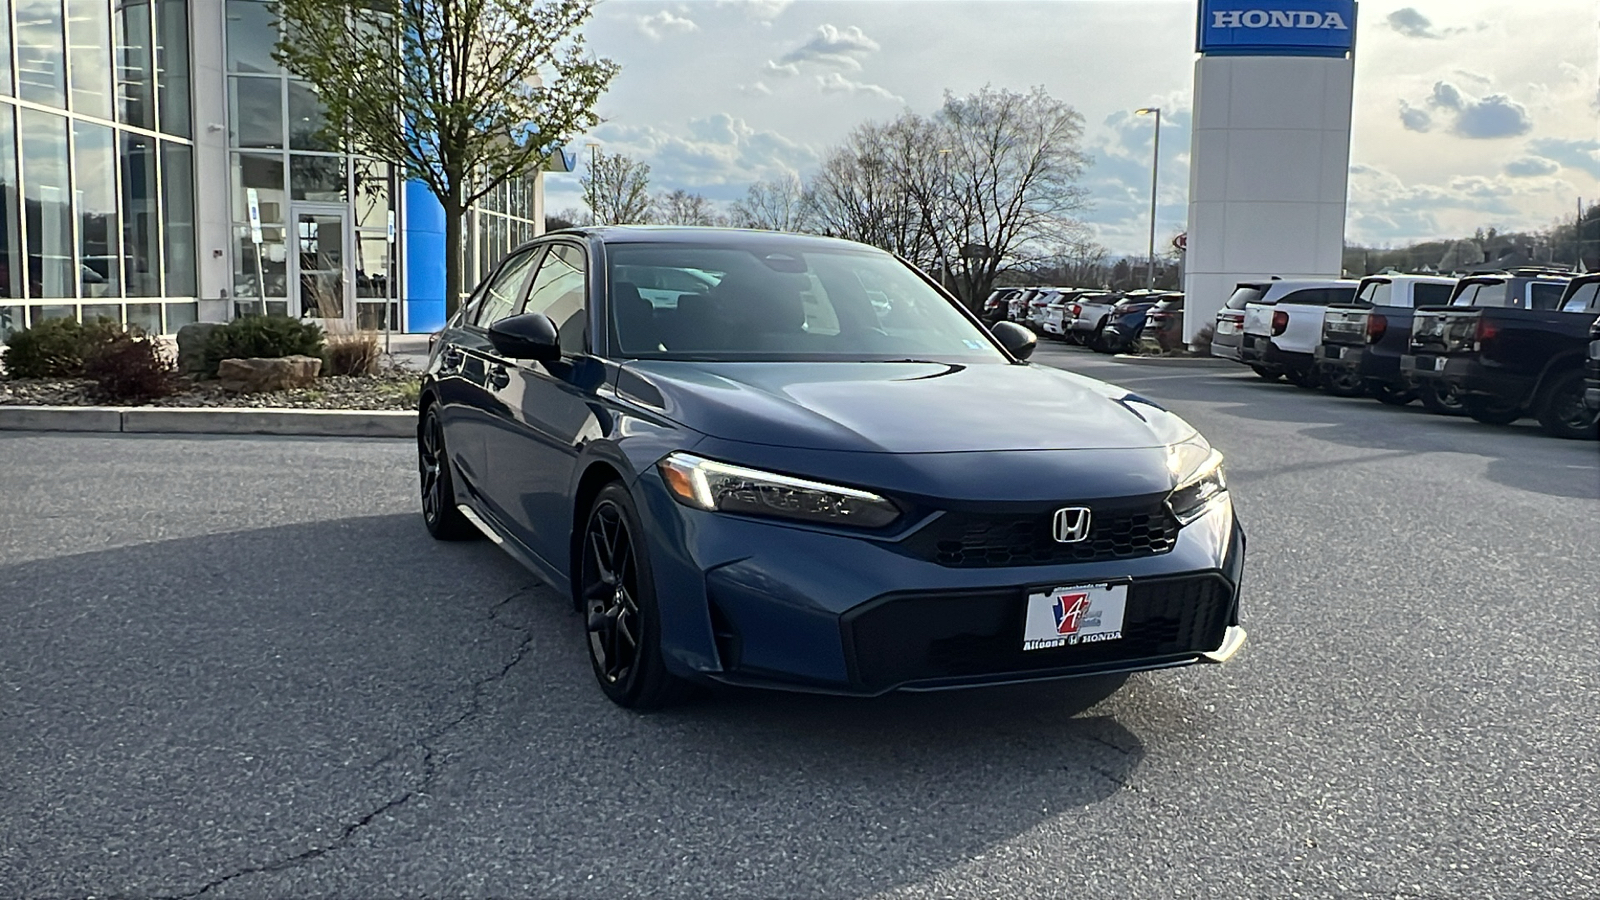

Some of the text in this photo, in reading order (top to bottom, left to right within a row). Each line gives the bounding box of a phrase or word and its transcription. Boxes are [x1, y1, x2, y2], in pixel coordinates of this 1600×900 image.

[1212, 10, 1348, 30] HONDA
[1023, 638, 1065, 651] Altoona
[1082, 631, 1122, 643] HONDA
